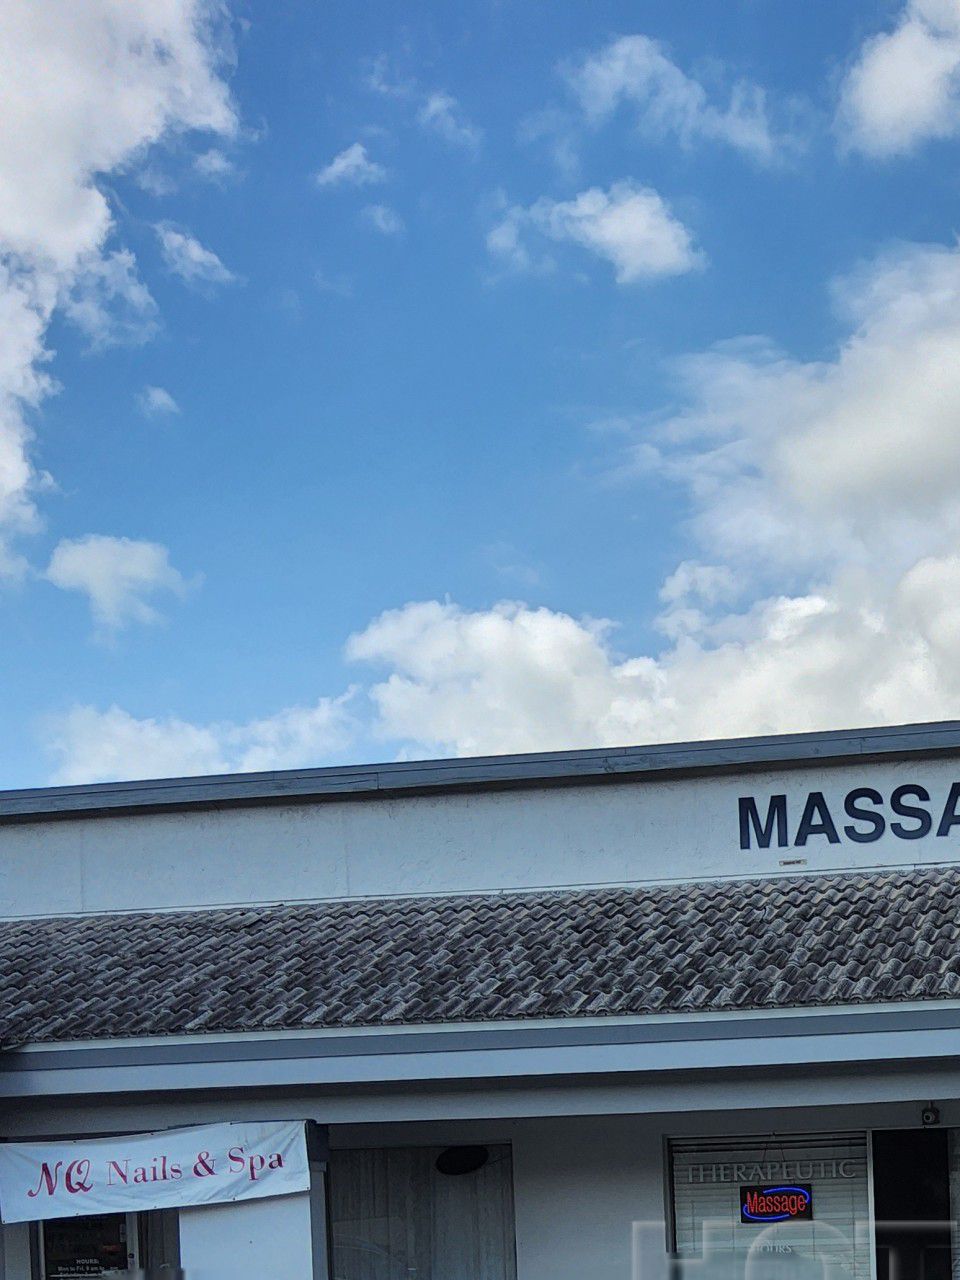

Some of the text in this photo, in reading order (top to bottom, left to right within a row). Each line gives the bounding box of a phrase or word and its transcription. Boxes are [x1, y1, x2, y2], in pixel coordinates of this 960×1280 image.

[26, 1145, 286, 1198] NQ Nails & Spa
[687, 1158, 857, 1184] THERAPEUTIC
[746, 1191, 807, 1216] Massage
